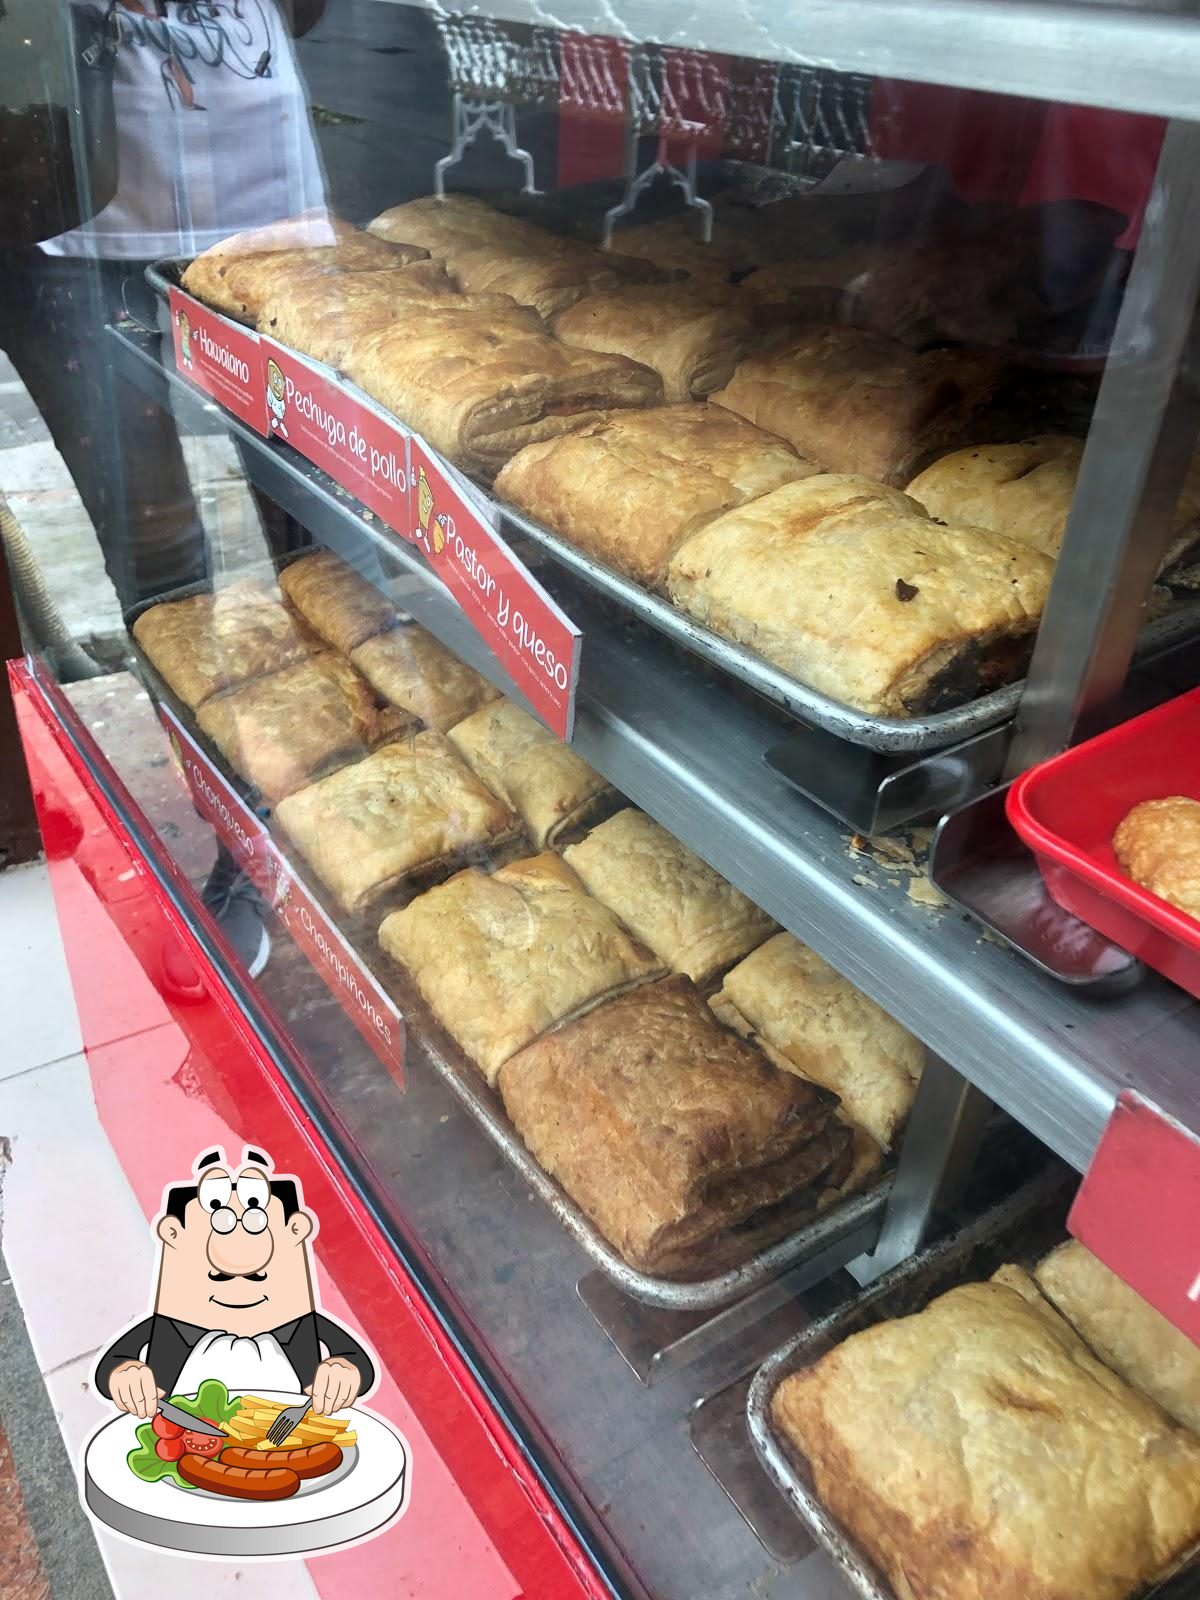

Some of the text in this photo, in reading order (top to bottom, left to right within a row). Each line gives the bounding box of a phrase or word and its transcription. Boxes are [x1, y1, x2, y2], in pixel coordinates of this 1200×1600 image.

[199, 325, 249, 384] Hawaiano
[285, 376, 347, 447] Pechuga
[349, 424, 367, 462] de
[370, 446, 407, 493] pollo
[445, 514, 496, 598] Pastor
[497, 590, 509, 627] y
[513, 611, 568, 690] queso
[301, 906, 393, 1046] Champiñones
